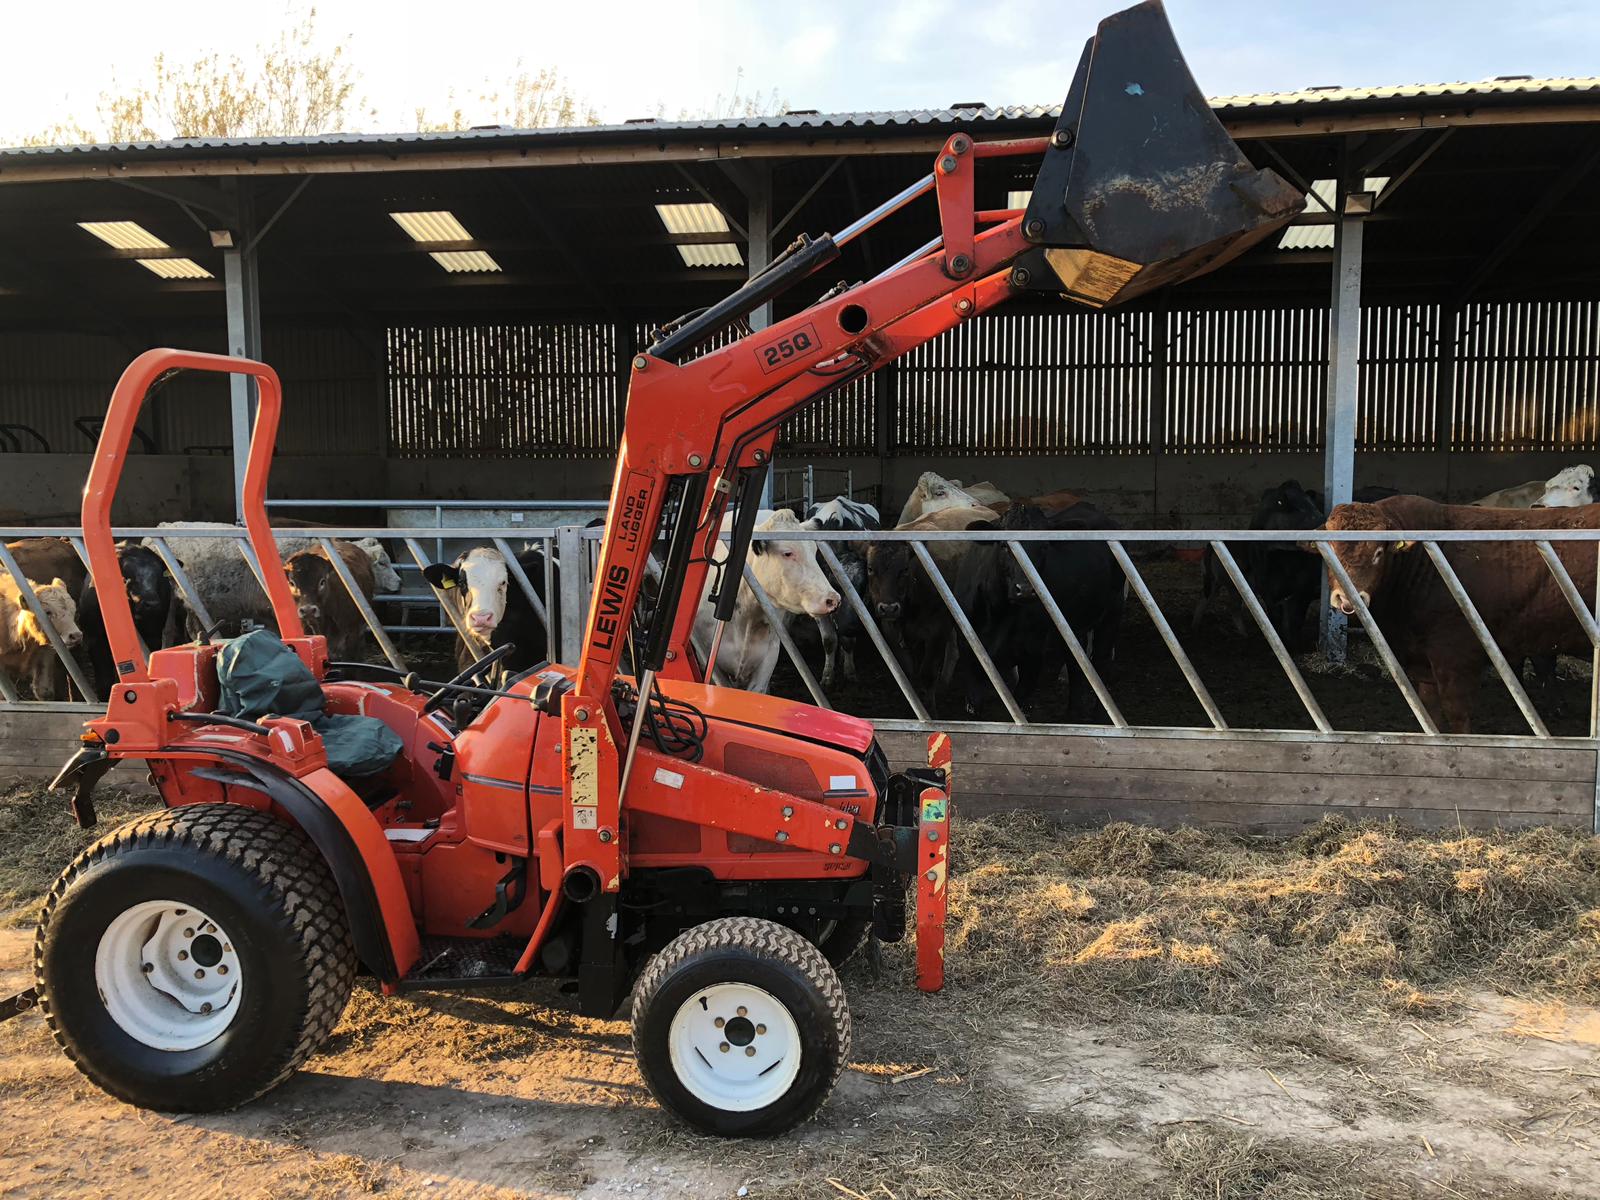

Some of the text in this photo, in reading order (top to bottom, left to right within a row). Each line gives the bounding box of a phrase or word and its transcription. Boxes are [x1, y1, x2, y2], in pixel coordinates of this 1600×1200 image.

[764, 332, 812, 366] 25Q
[618, 495, 636, 540] LAND
[625, 489, 649, 553] LUGGER
[592, 564, 630, 651] LEWIS
